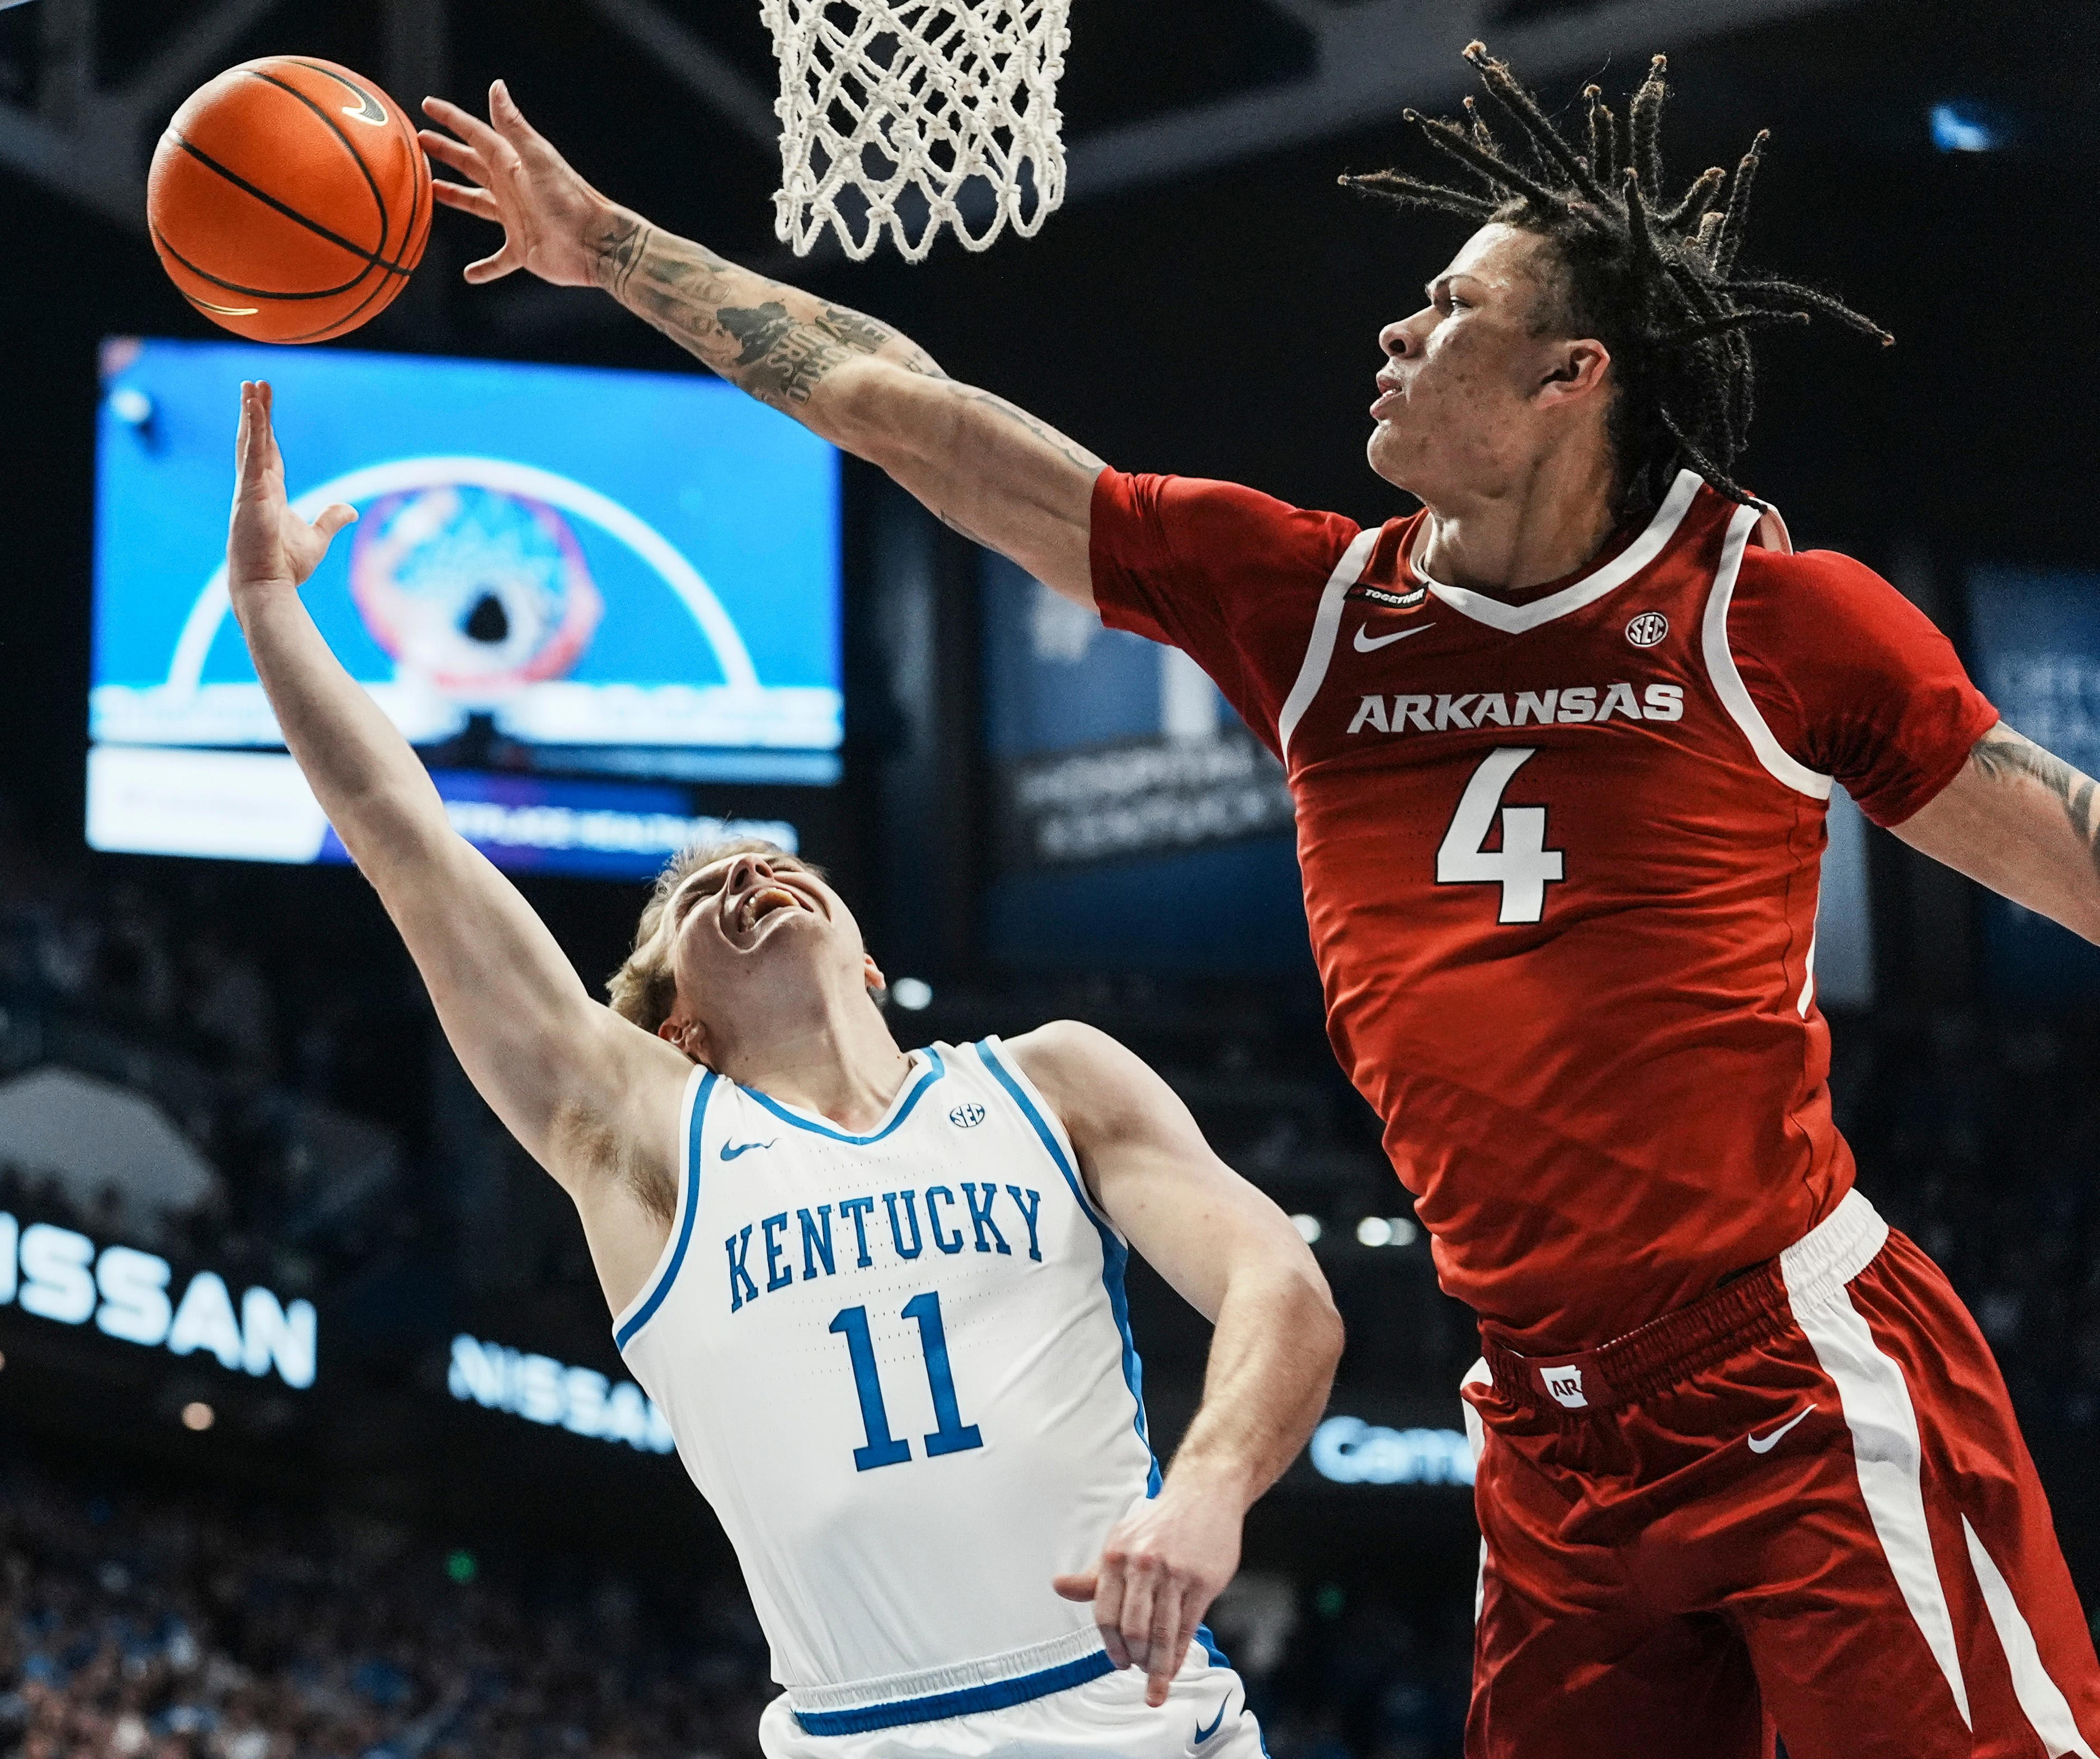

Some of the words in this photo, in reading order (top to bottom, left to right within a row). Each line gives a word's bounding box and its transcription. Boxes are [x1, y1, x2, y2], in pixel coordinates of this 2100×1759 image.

[1365, 588, 1425, 604] TOGETHER
[1629, 616, 1664, 644] SEC
[1346, 683, 1684, 734] ARKANSAS
[1435, 745, 1566, 926] 4
[950, 1103, 985, 1128] SEC
[725, 1182, 1043, 1314] KENTUCKY
[829, 1291, 984, 1472] 11
[1551, 1379, 1582, 1397] AR
